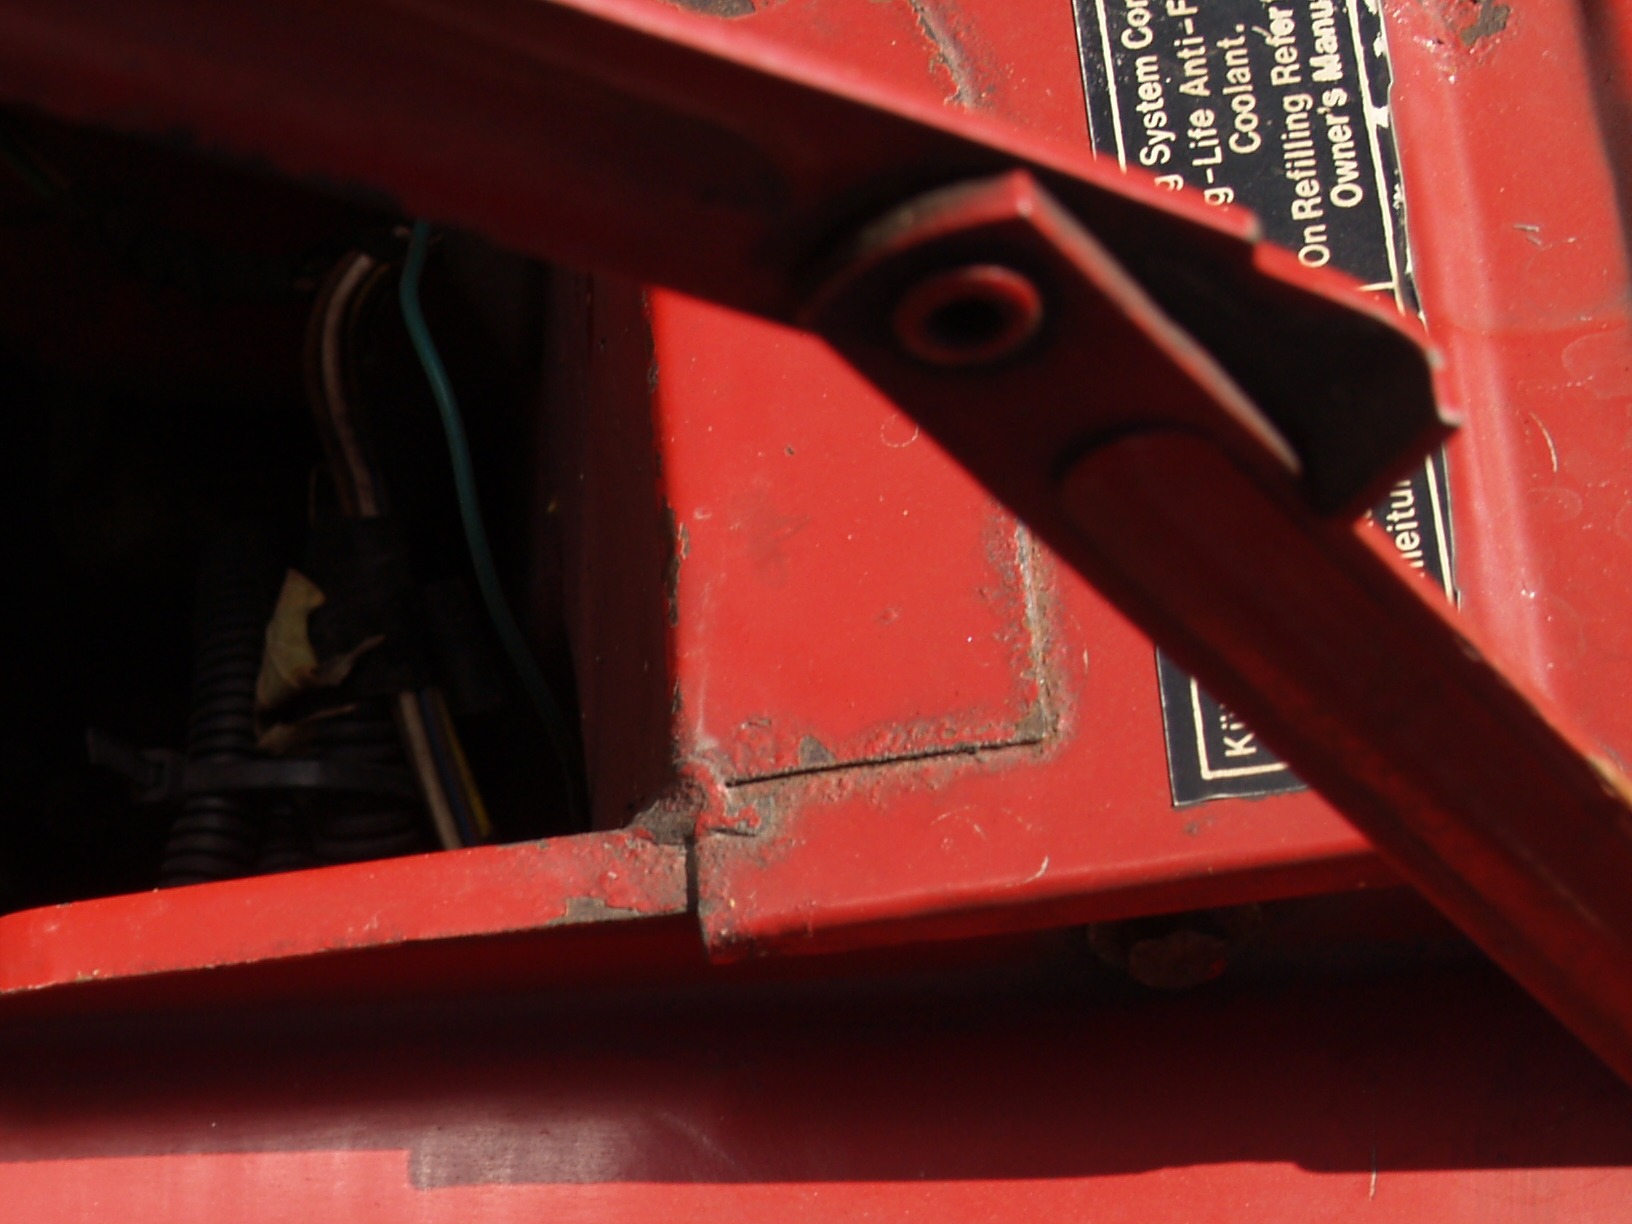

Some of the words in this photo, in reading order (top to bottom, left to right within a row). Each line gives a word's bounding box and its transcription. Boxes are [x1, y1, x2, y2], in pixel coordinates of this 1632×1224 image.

[1216, 23, 1262, 154] Coolant.
[1265, 6, 1303, 86] Refer
[1135, 55, 1178, 166] System
[1187, 108, 1235, 211] g-Life
[1282, 93, 1324, 221] Refilling
[1316, 87, 1364, 208] Owner's
[1297, 223, 1331, 268] On
